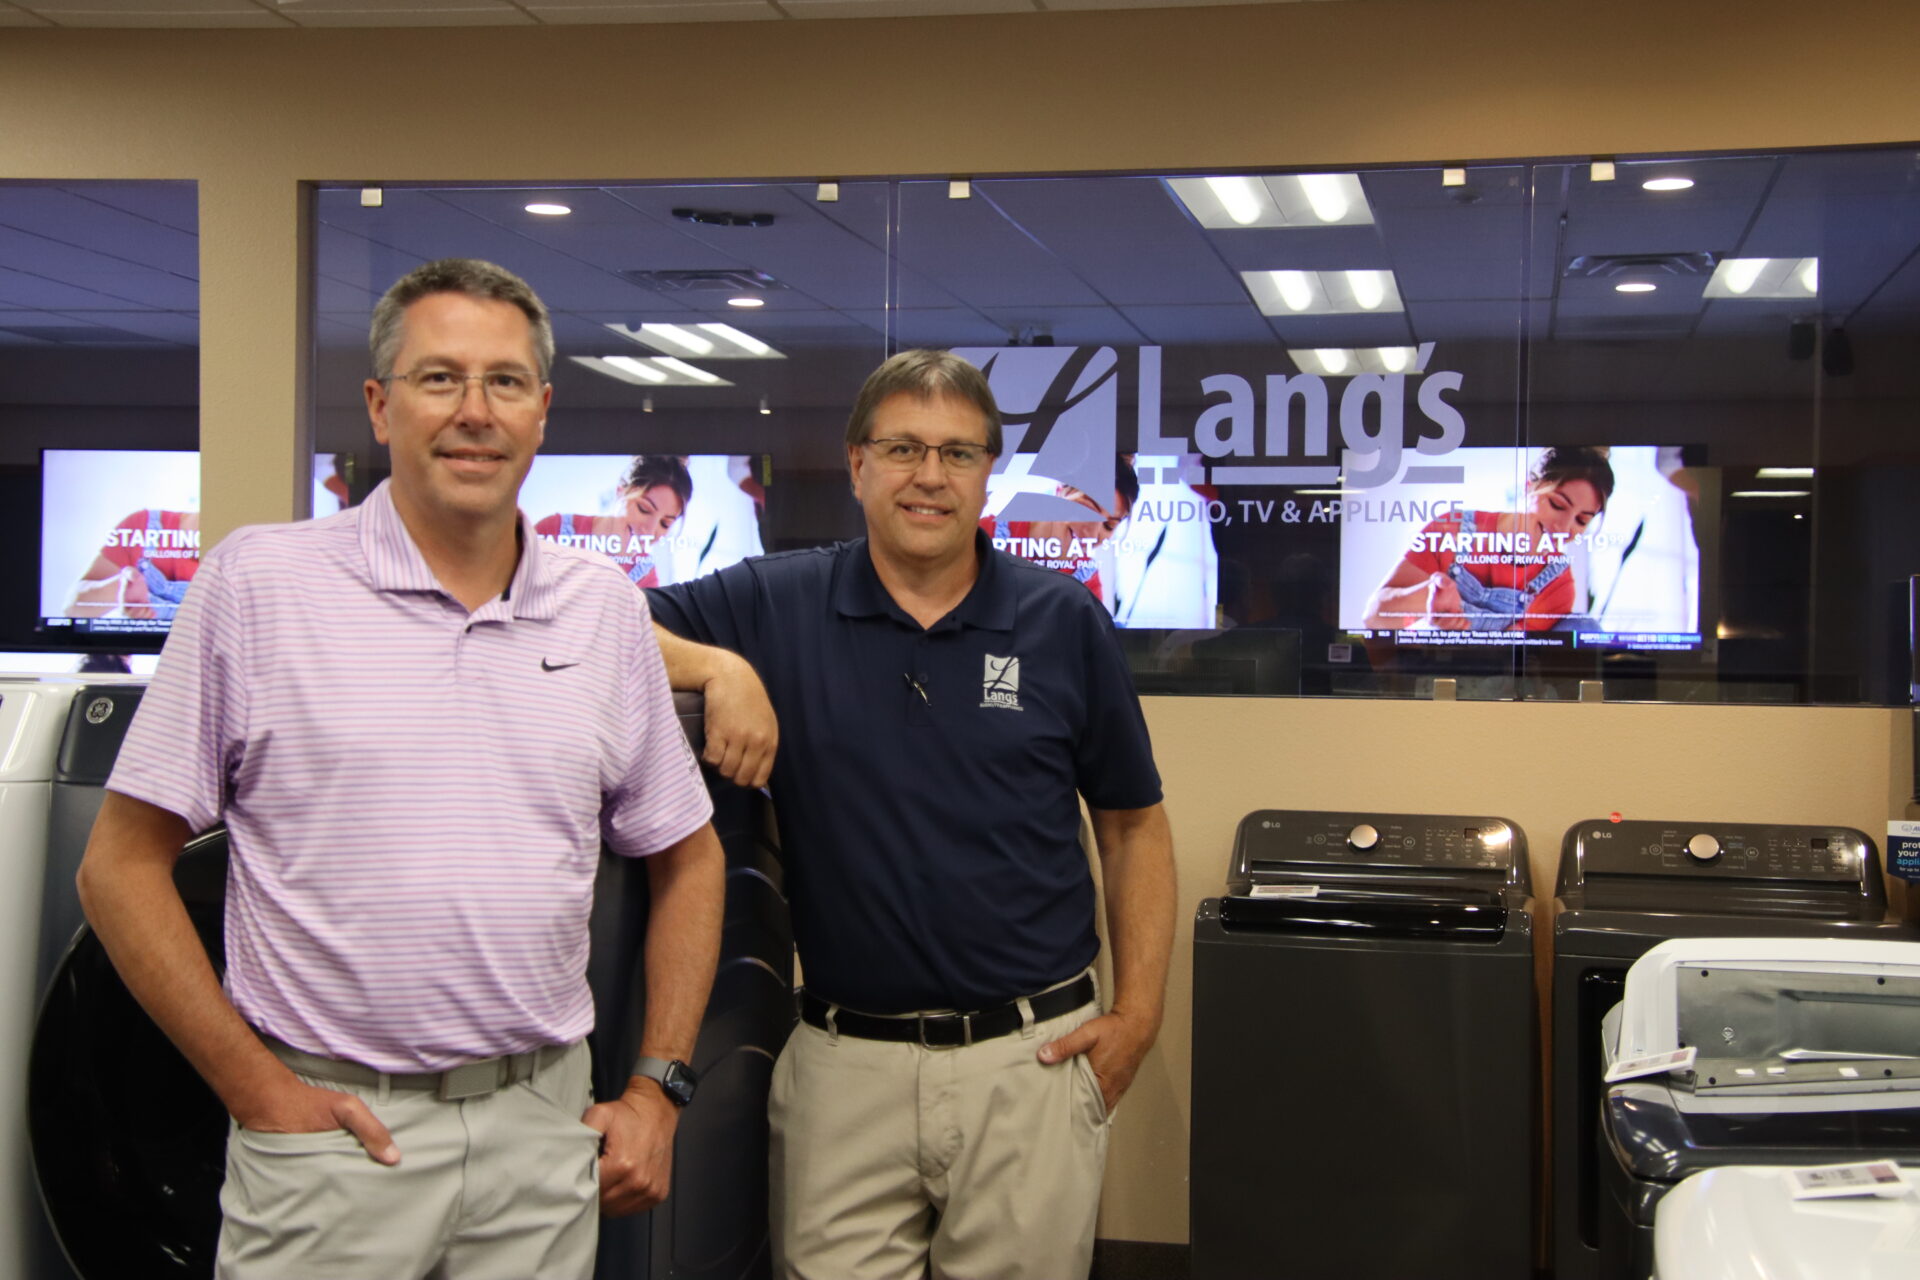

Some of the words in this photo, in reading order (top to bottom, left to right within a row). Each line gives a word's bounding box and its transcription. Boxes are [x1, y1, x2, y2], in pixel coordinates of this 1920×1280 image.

[1137, 342, 1466, 488] Lang's
[1137, 500, 1232, 527] AUDIO,
[1238, 500, 1275, 523] TV
[1281, 500, 1300, 523] &
[1308, 500, 1465, 523] APPLIANCE
[537, 534, 622, 554] RTING
[626, 534, 655, 553] AT
[992, 537, 1062, 558] RTING
[1066, 537, 1098, 558] AT
[1410, 531, 1531, 553] STARTING
[1537, 532, 1569, 553] AT
[611, 556, 634, 565] OYAL
[1046, 560, 1075, 570] ROYAL
[1456, 554, 1499, 565] GALLONS
[1500, 555, 1513, 565] OF
